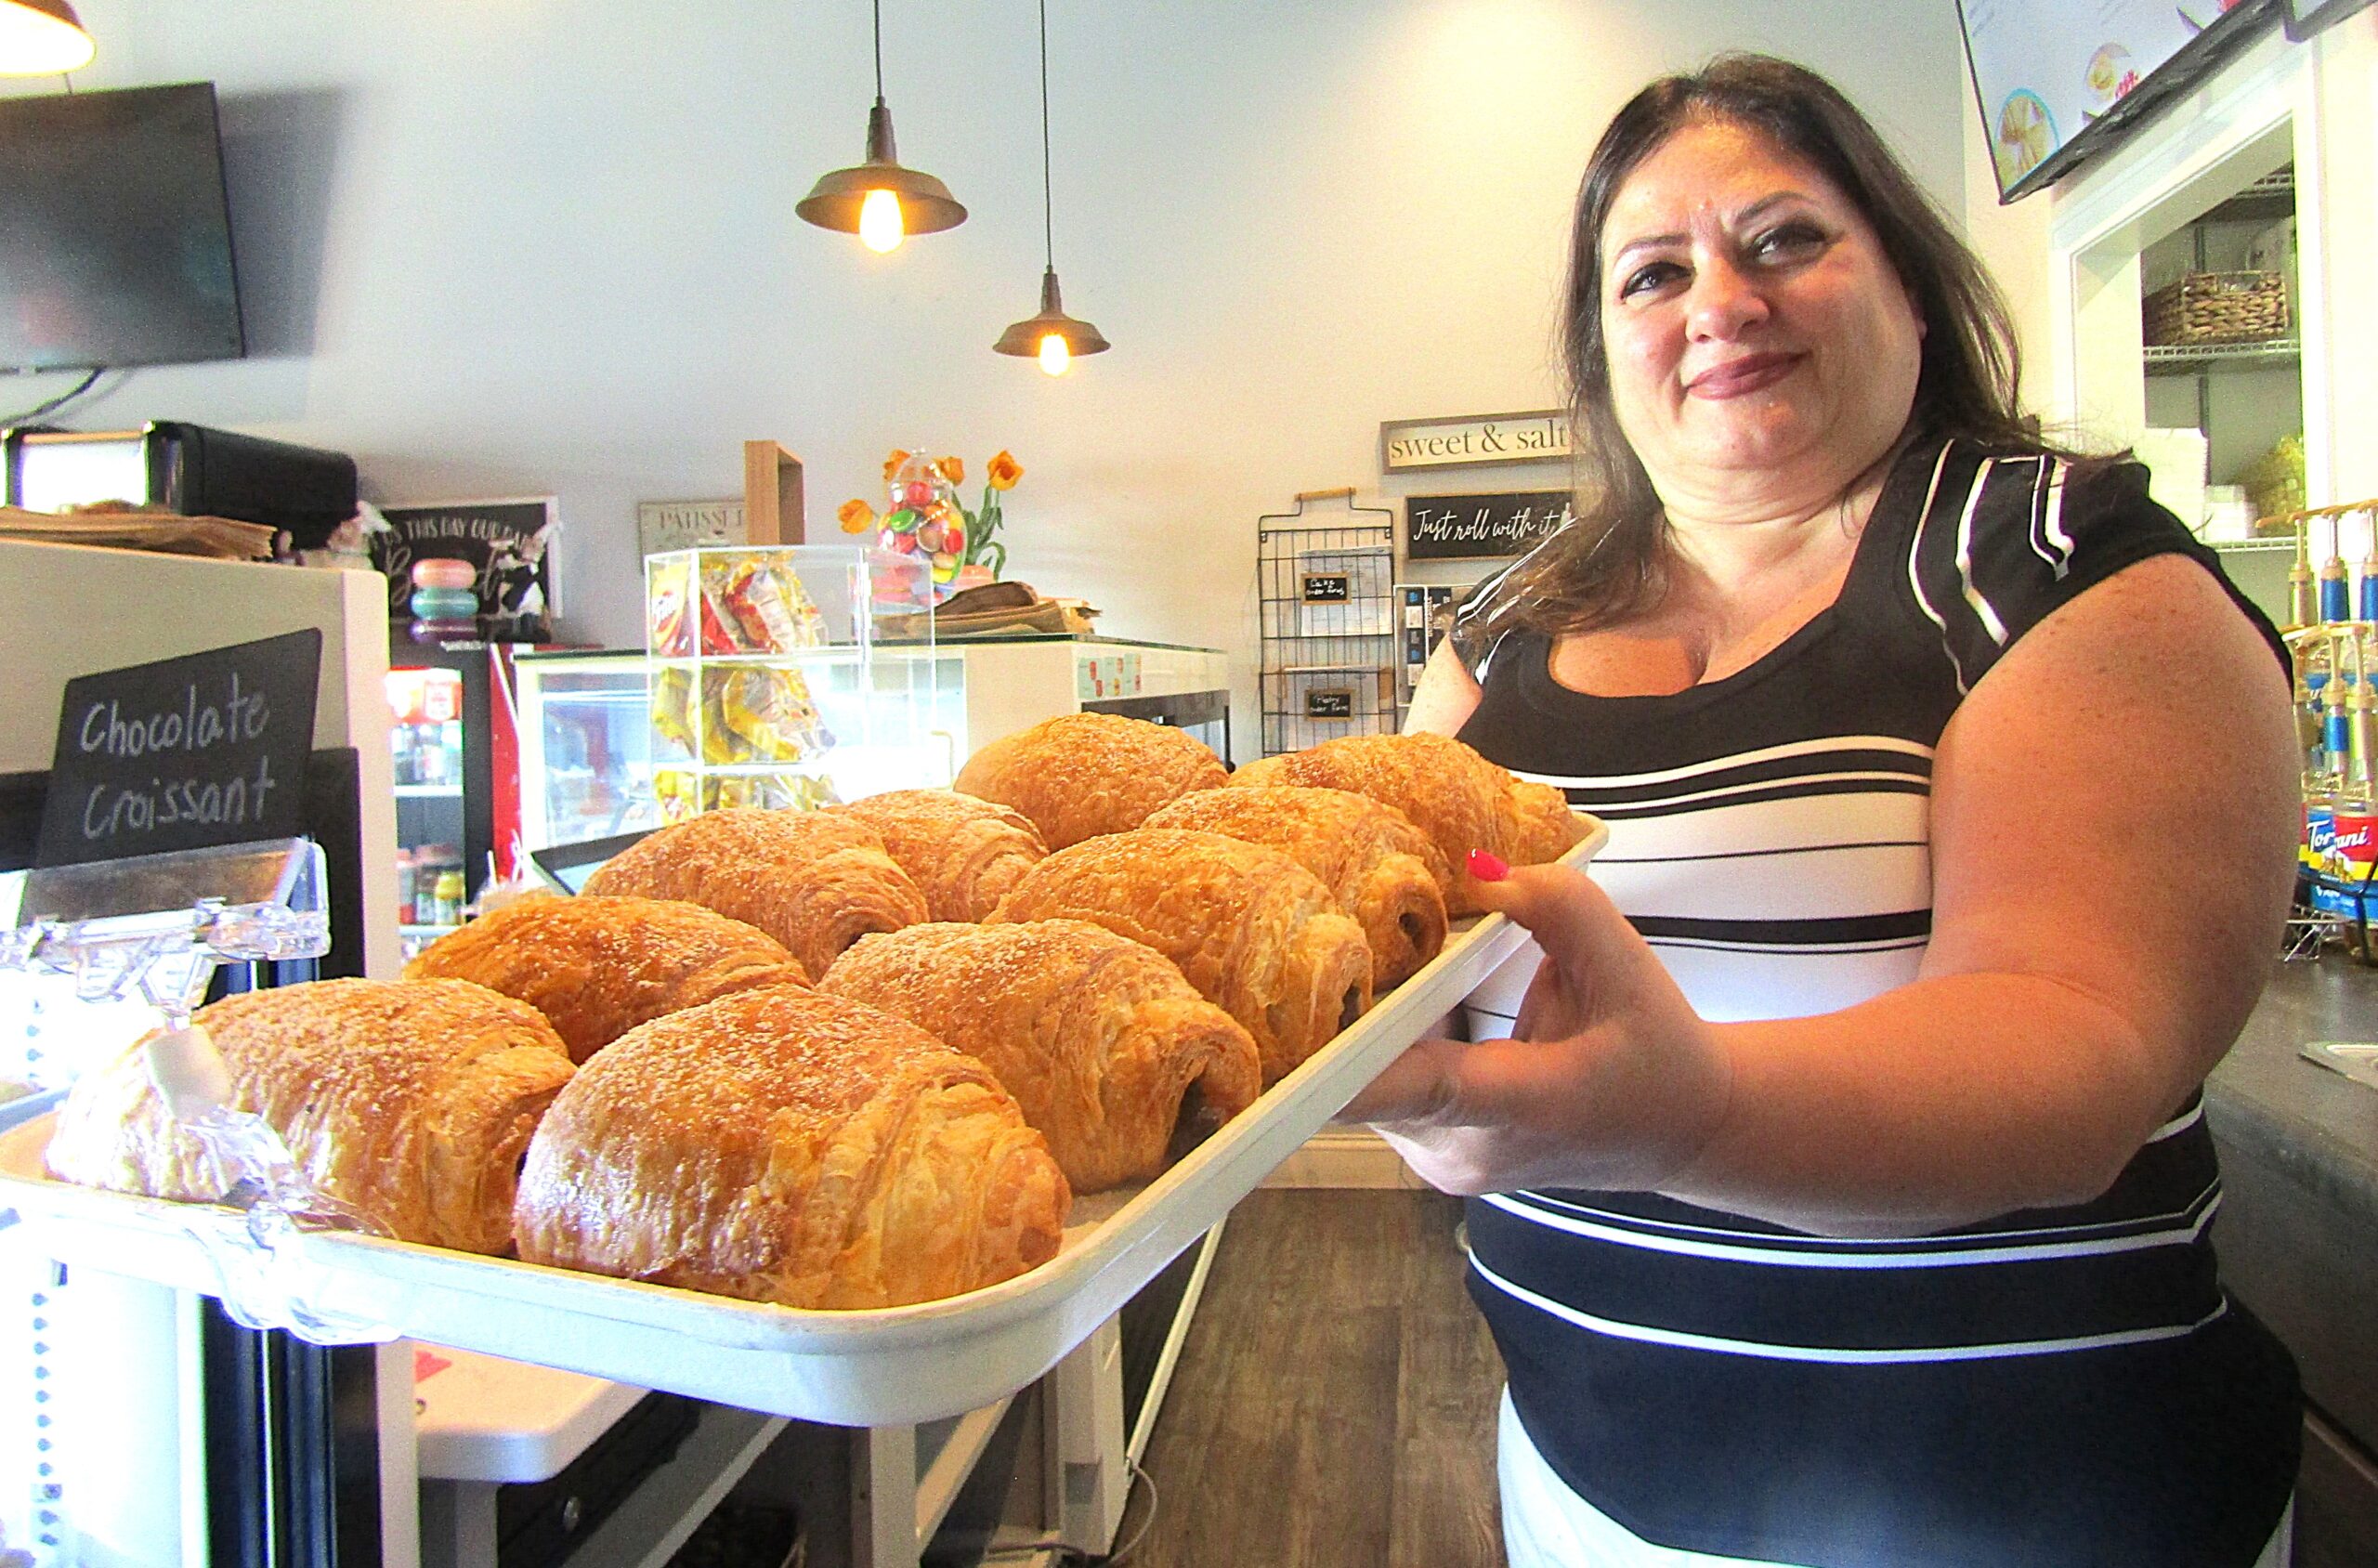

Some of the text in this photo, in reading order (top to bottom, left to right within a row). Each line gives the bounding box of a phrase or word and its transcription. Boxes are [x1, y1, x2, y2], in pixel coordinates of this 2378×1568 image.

[1391, 430, 1472, 459] sweet
[1481, 424, 1507, 452] &
[405, 517, 438, 541] THIS
[439, 516, 467, 539] DAY
[470, 518, 501, 541] OUR
[1413, 509, 1457, 541] Just
[1453, 508, 1490, 541] roll
[1492, 507, 1536, 540] with
[80, 672, 269, 757] Chocolate
[85, 755, 275, 840] Croissant
[2306, 819, 2369, 853] Torani
